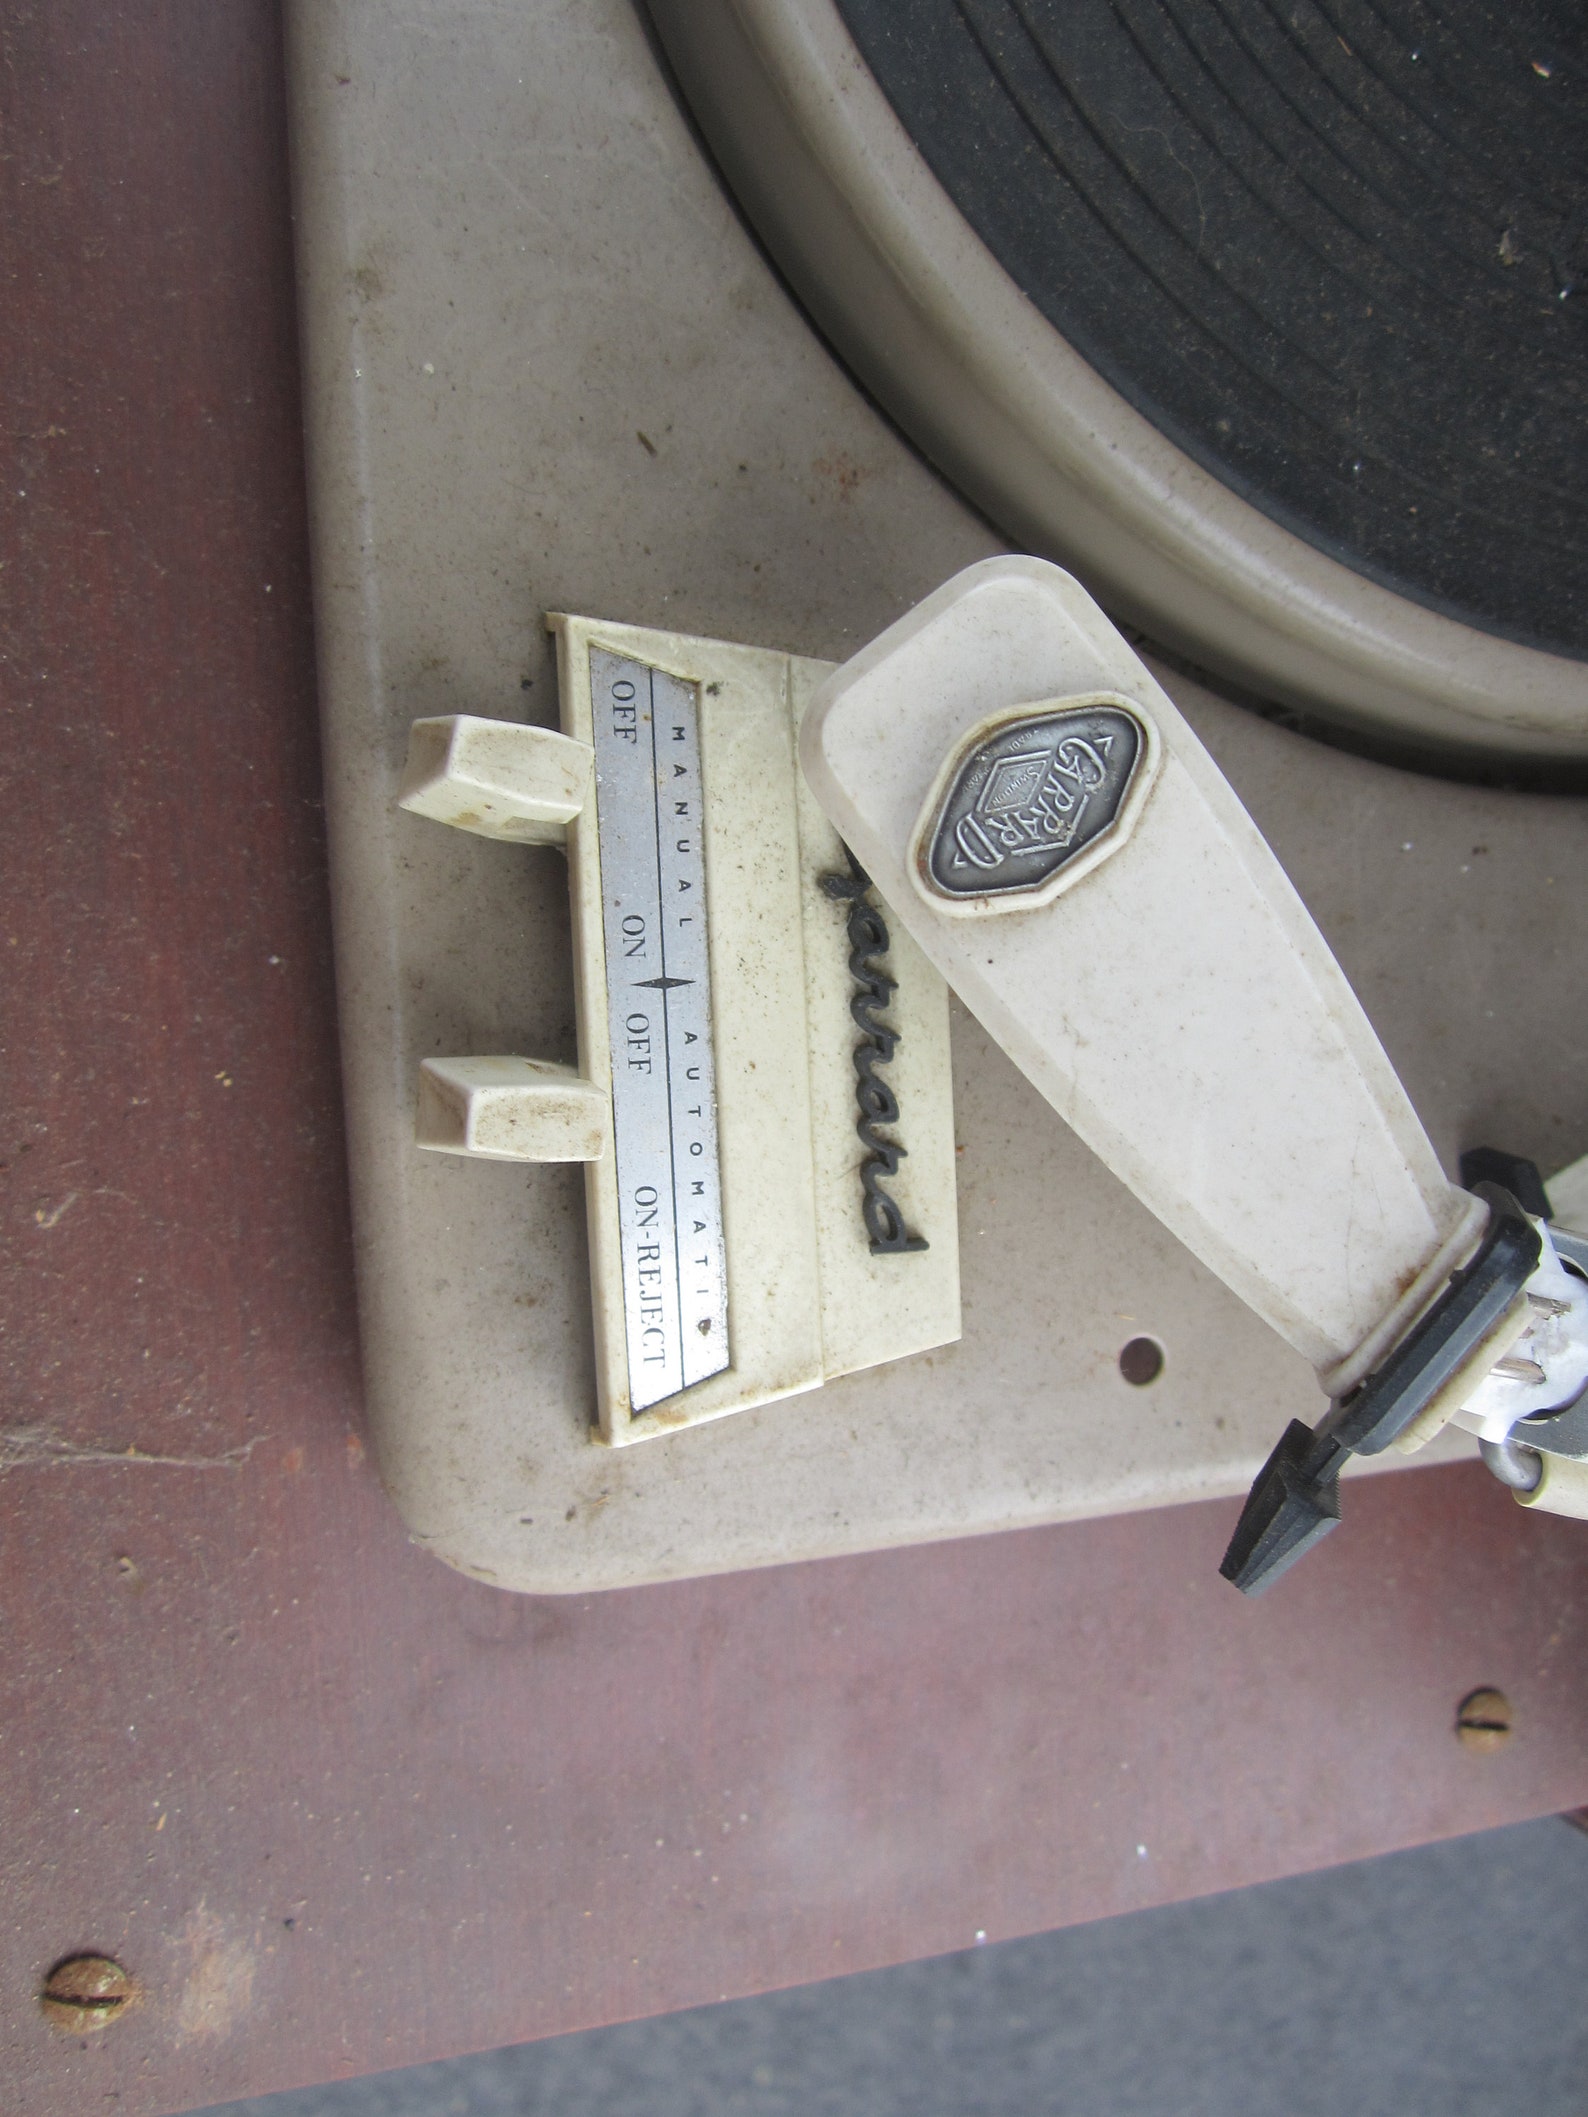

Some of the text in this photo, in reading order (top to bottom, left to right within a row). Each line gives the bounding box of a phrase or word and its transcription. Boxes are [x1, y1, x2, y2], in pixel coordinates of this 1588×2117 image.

[611, 680, 638, 744] OFF
[671, 726, 693, 928] MANUAL
[955, 736, 1107, 870] GARRARD
[621, 914, 647, 958] ON
[625, 1013, 652, 1075] OFF
[684, 1031, 712, 1337] AUTOMATI
[634, 1185, 666, 1369] ON-REJECT
